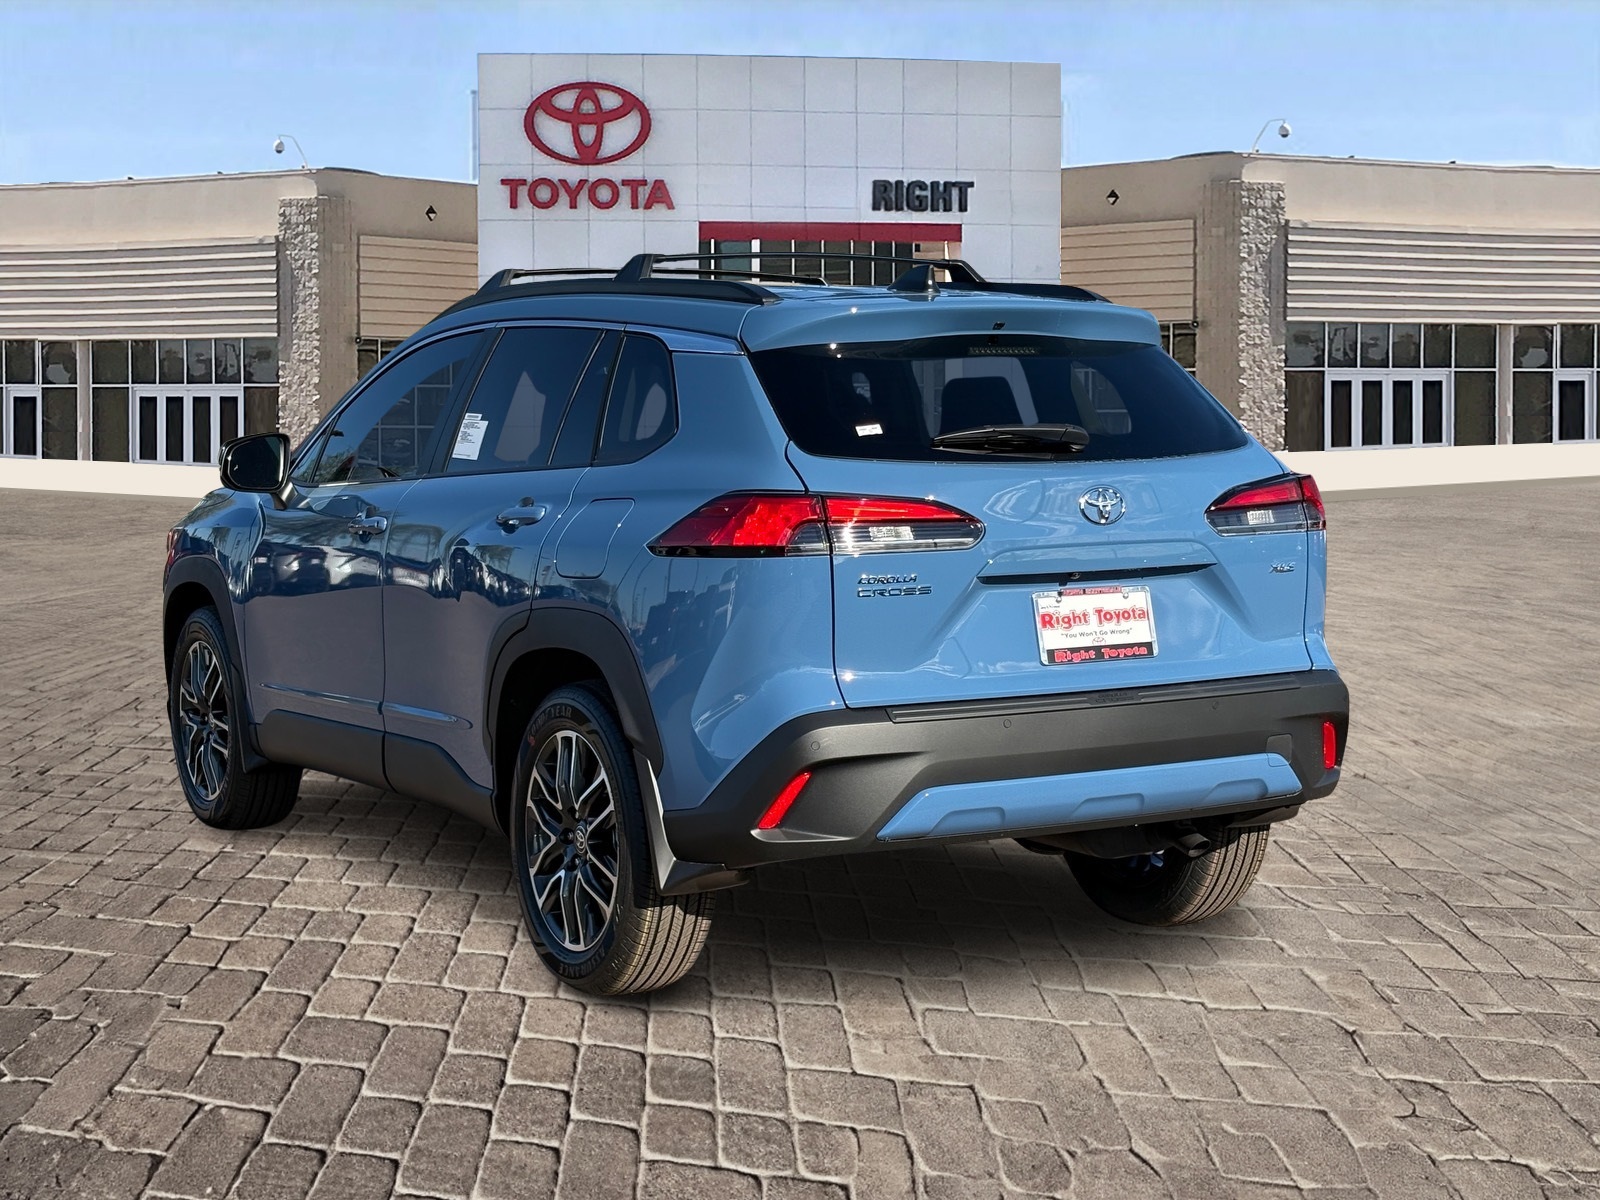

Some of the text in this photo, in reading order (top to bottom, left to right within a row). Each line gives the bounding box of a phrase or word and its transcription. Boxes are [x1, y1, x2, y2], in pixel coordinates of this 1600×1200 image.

[500, 178, 675, 209] TOYOTA
[872, 180, 976, 212] RIGHT
[857, 574, 917, 584] COROLLA
[857, 585, 932, 597] CROSS
[1040, 606, 1147, 631] Right Toyota
[1054, 646, 1147, 662] Right Toyota
